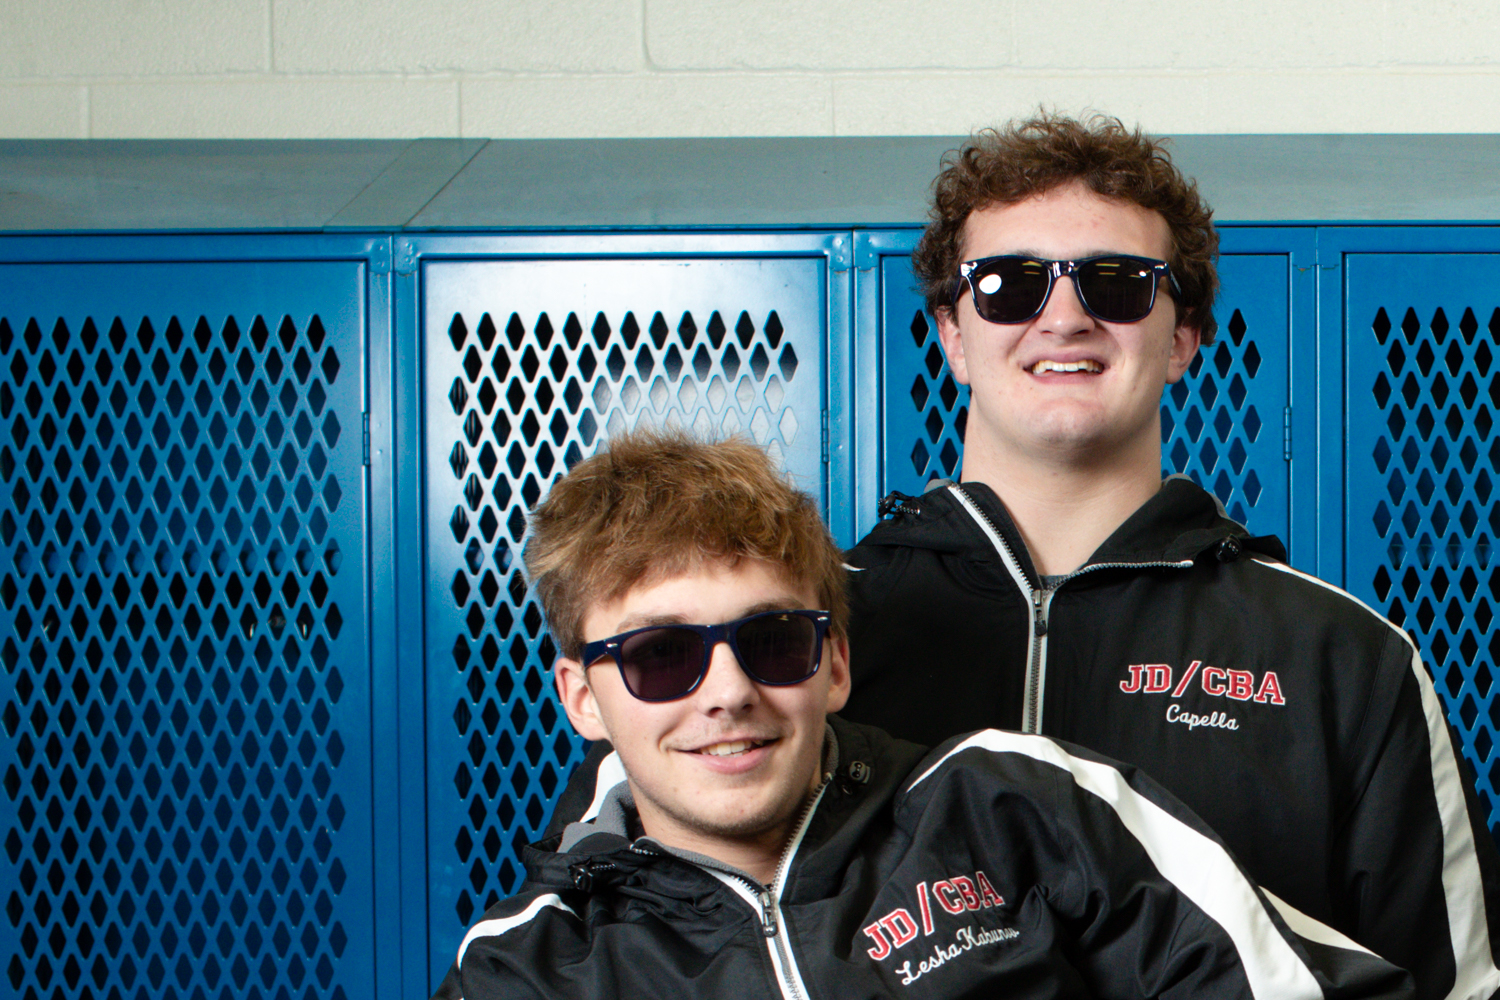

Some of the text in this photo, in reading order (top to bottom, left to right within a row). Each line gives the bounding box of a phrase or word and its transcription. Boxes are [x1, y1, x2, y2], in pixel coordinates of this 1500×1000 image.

[1119, 660, 1286, 705] JD/CBA
[1166, 704, 1239, 731] Capella
[862, 870, 1006, 961] JD/CBA
